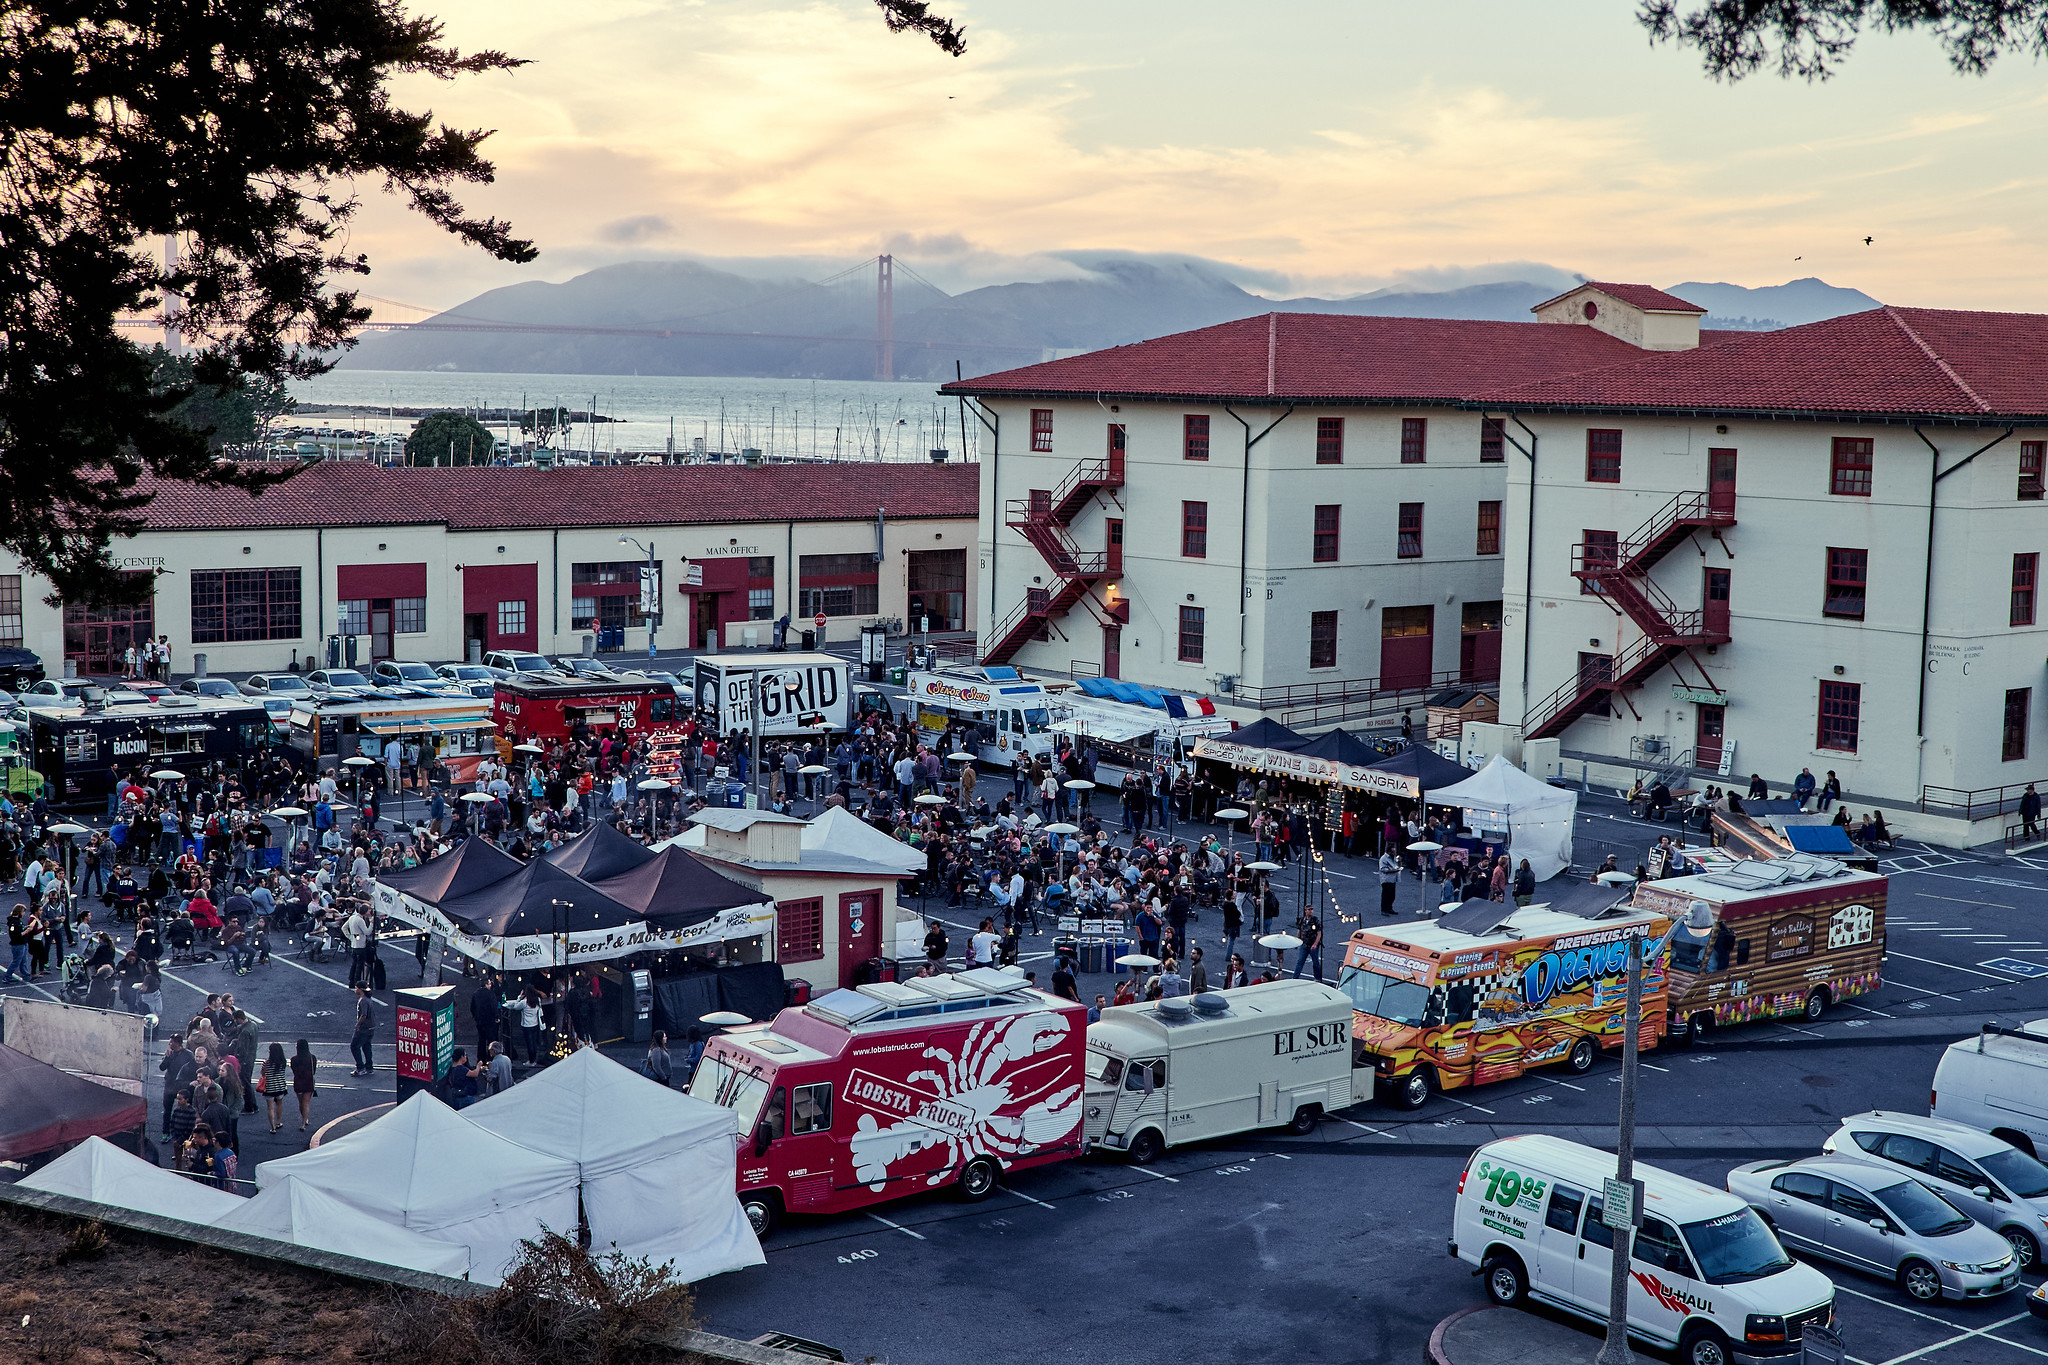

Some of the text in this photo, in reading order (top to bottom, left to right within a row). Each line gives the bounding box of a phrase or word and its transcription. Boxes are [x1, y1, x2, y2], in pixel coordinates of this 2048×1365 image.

[706, 546, 759, 555] MAIN OFFICE
[124, 557, 165, 566] CENTER
[980, 559, 986, 569] B
[1246, 587, 1252, 598] B
[1266, 589, 1273, 600] B
[815, 616, 826, 624] STOP
[1504, 615, 1512, 626] C
[1929, 644, 1960, 652] LANDMARK
[1928, 660, 1938, 673] C
[1963, 662, 1970, 675] C
[761, 668, 837, 717] GRID
[618, 701, 636, 711] AN
[618, 719, 636, 729] GO
[113, 740, 147, 755] BACON
[1218, 743, 1244, 754] WARM
[1203, 748, 1257, 764] SPICED WINE
[1267, 754, 1338, 777] WINE BAR
[1351, 772, 1409, 792] SANGRIA
[32, 829, 40, 838] 30
[404, 904, 426, 920] Beer!
[426, 915, 432, 923] &
[431, 916, 450, 935] More
[568, 922, 711, 954] Beer! & More Beer!
[1555, 924, 1650, 950] DREWSKIS.COM
[1353, 945, 1430, 973] DREWSKIS.COM
[1454, 952, 1483, 964] Catering
[1446, 965, 1471, 976] Private
[1472, 962, 1495, 972] Events
[404, 1027, 417, 1039] GRID
[1273, 1022, 1347, 1056] EL SUR
[398, 1040, 430, 1057] RETAIL
[853, 1042, 924, 1055] www.lobstatruck.com
[1099, 1041, 1112, 1051] SUR
[410, 1059, 428, 1073] Shop
[852, 1078, 967, 1129] LOBSTA TRUCK
[1517, 1197, 1540, 1210] IN-TOWN
[1608, 1201, 1626, 1209] PARKING
[1479, 1205, 1528, 1228] Rent This Van!
[1713, 1214, 1740, 1226] U-HAUL
[1486, 1220, 1521, 1237] uhaul.com
[836, 1248, 879, 1266] 440
[1661, 1284, 1715, 1314] U-HAUL
